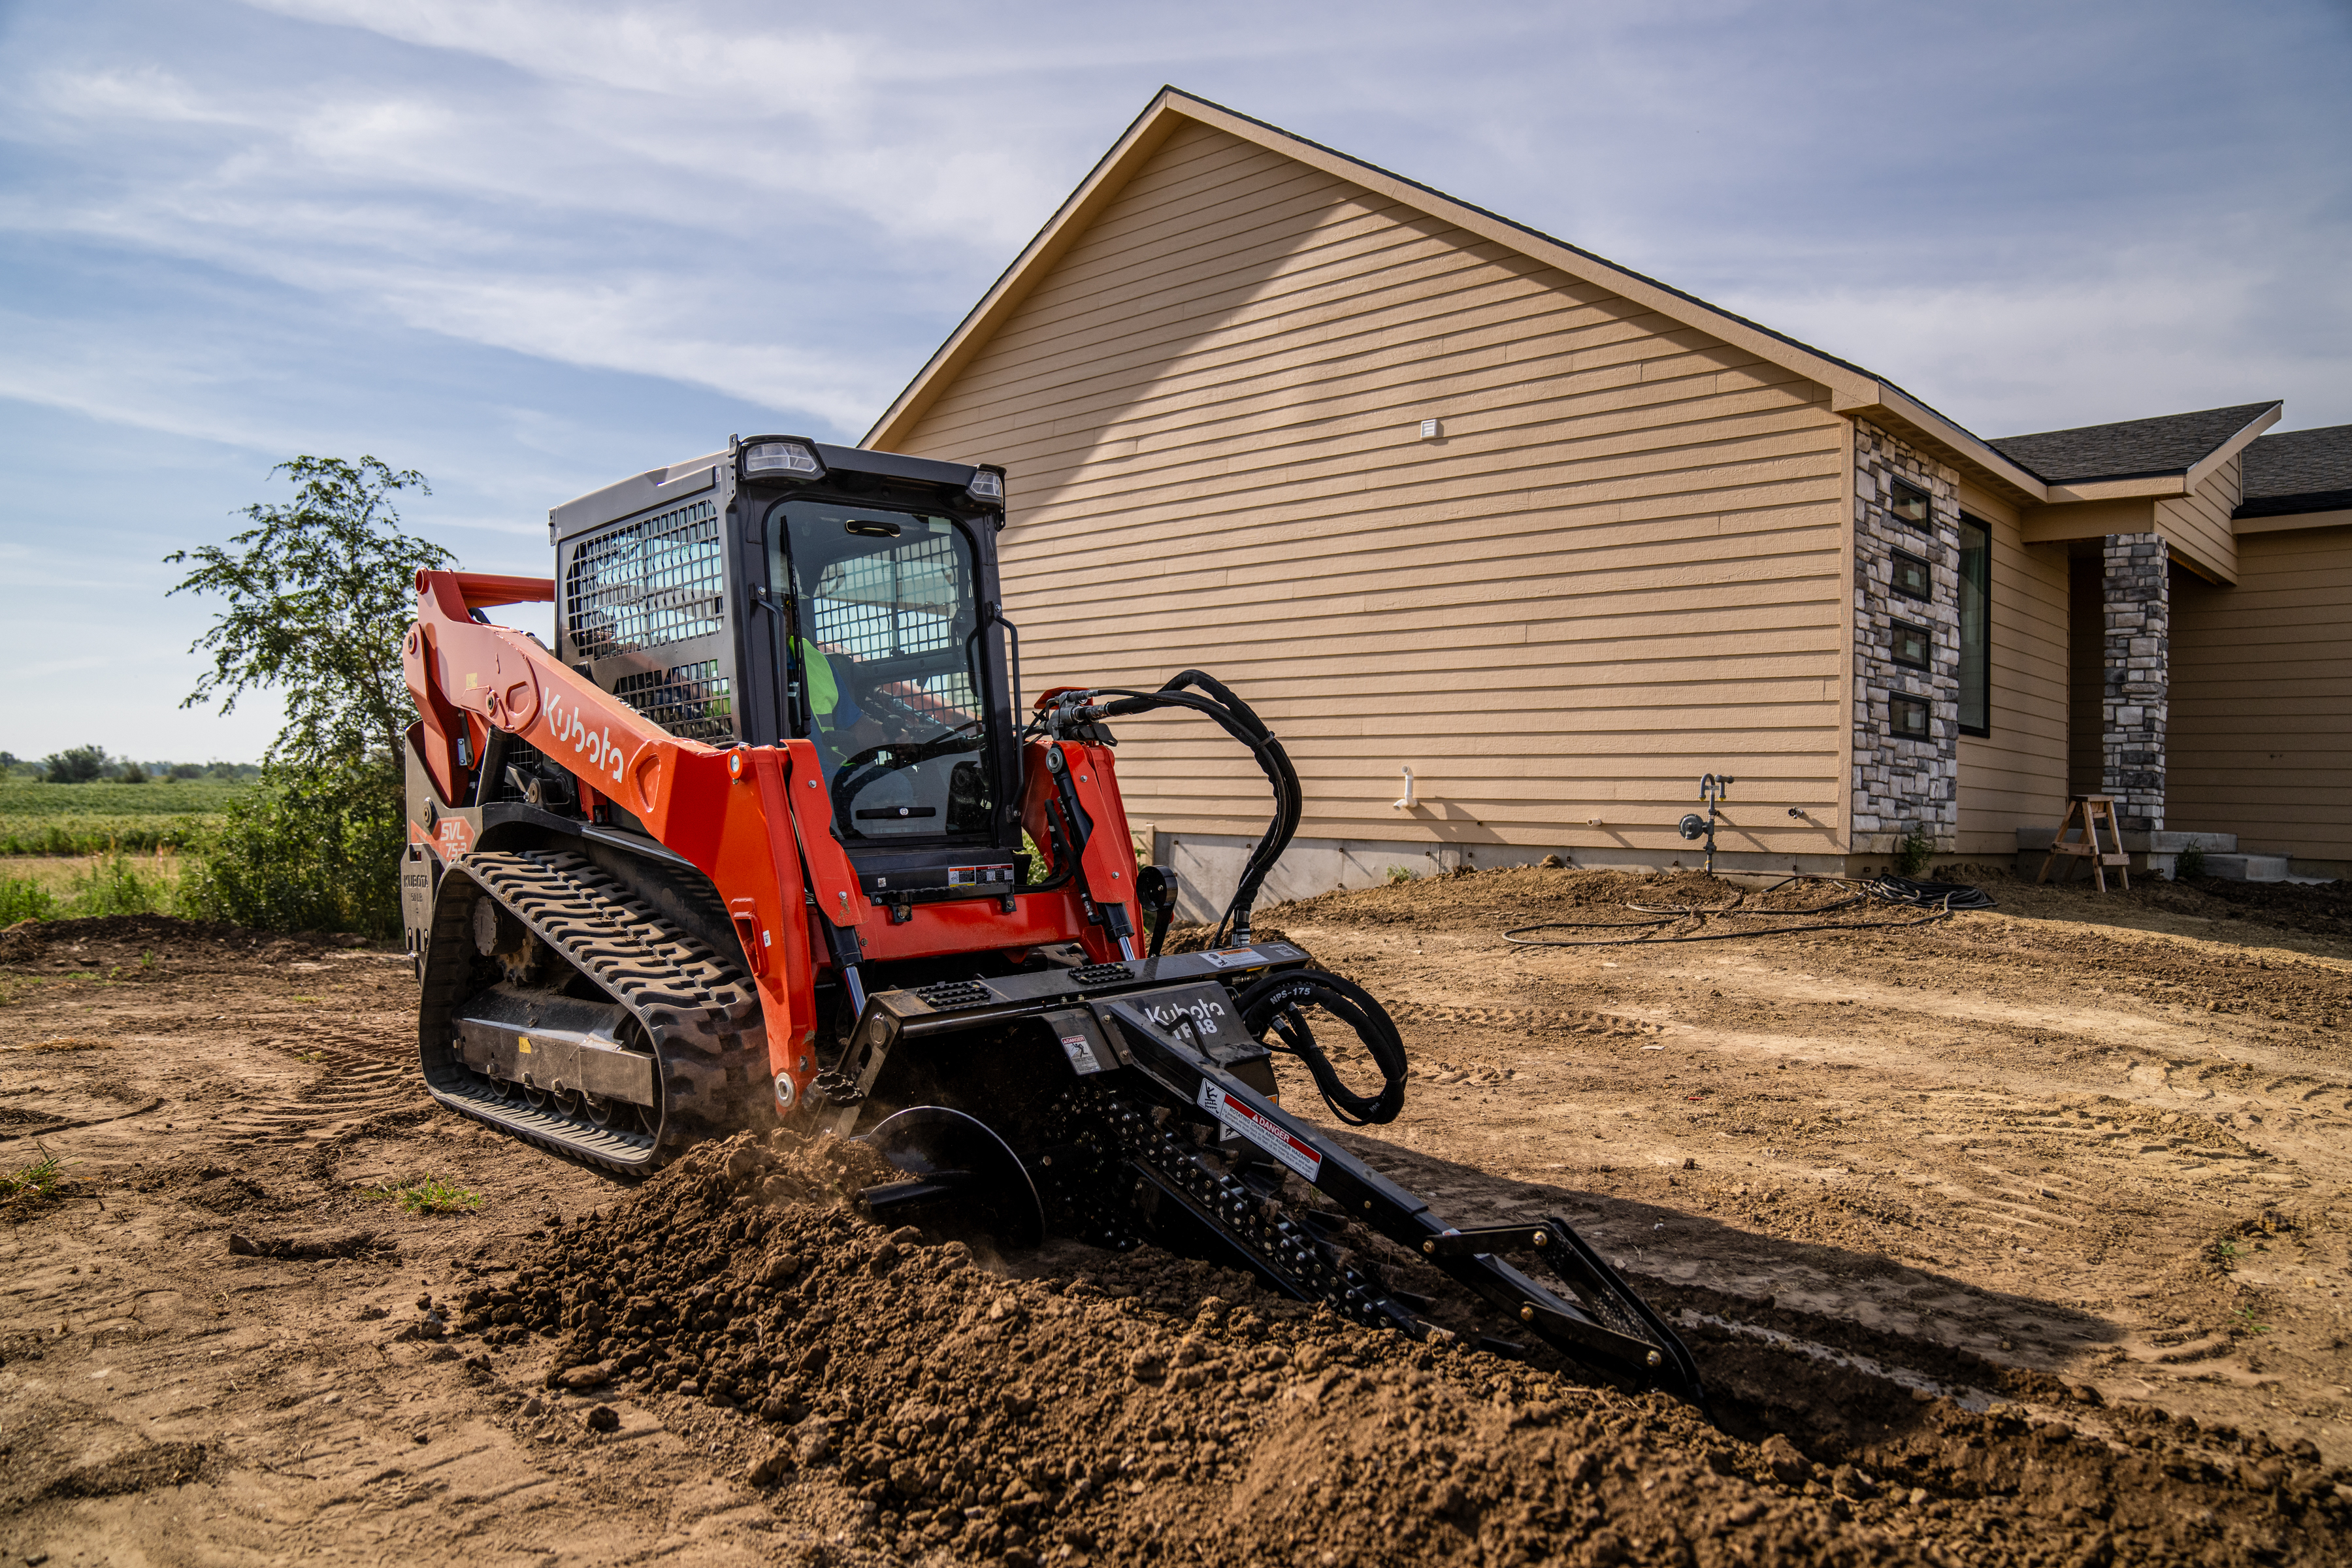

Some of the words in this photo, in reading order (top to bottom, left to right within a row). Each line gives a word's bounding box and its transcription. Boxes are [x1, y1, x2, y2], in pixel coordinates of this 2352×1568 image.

[543, 687, 624, 783] Kubota
[440, 822, 465, 841] SVL
[446, 842, 467, 858] 75-3
[404, 875, 429, 889] KUBOTA
[411, 893, 417, 902] 50
[417, 894, 423, 902] LB
[1270, 987, 1311, 1004] NPS-175
[1145, 999, 1225, 1026] Kubota
[1230, 1107, 1250, 1124] ROTATING
[1251, 1122, 1264, 1133] CHAIN
[1266, 1131, 1275, 1140] AND
[1275, 1137, 1290, 1151] AUGER
[1292, 1149, 1310, 1164] HAZARD
[1260, 1117, 1290, 1143] DANGER
